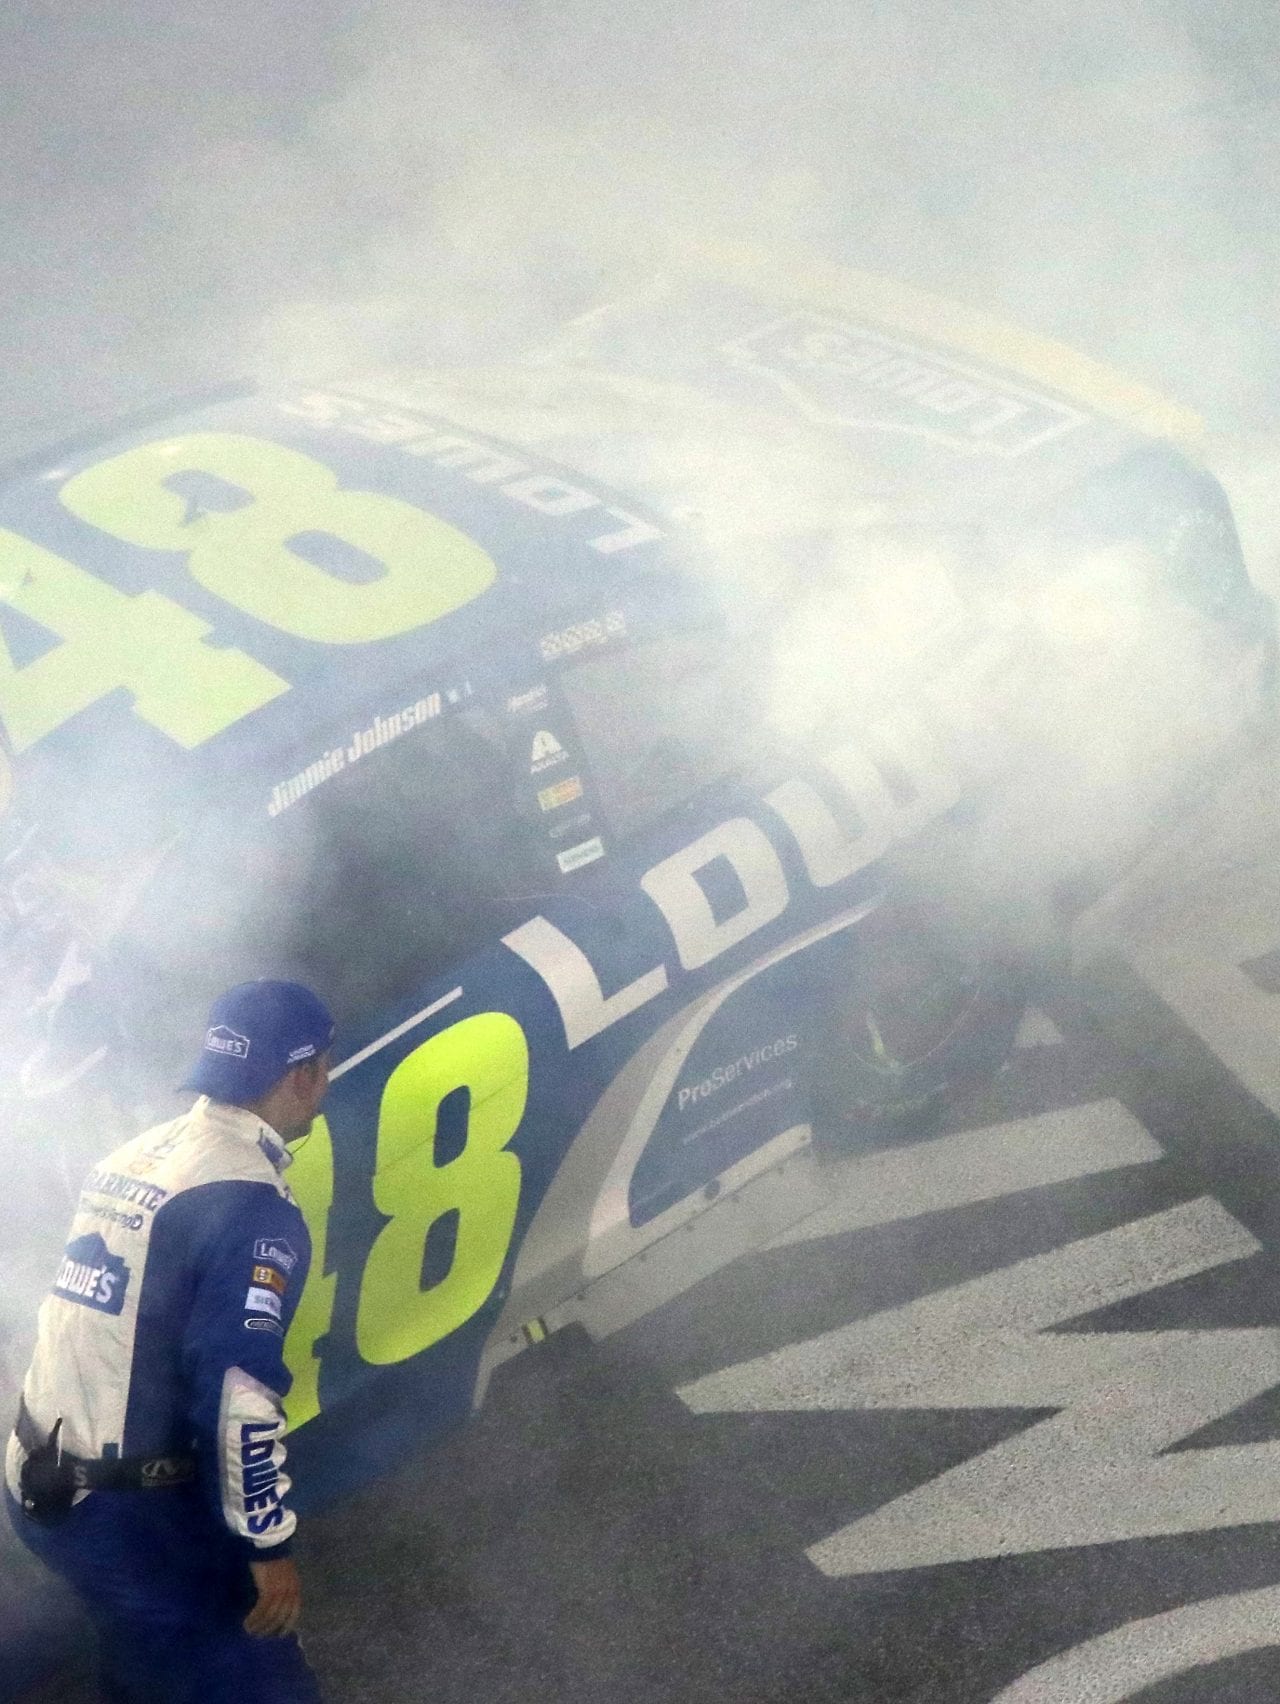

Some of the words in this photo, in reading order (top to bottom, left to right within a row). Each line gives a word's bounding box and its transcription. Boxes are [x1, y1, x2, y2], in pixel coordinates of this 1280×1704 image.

[0, 432, 498, 757] 48
[348, 692, 441, 763] Johnson
[677, 1034, 798, 1112] ProServices
[241, 1421, 284, 1534] LOWE'S
